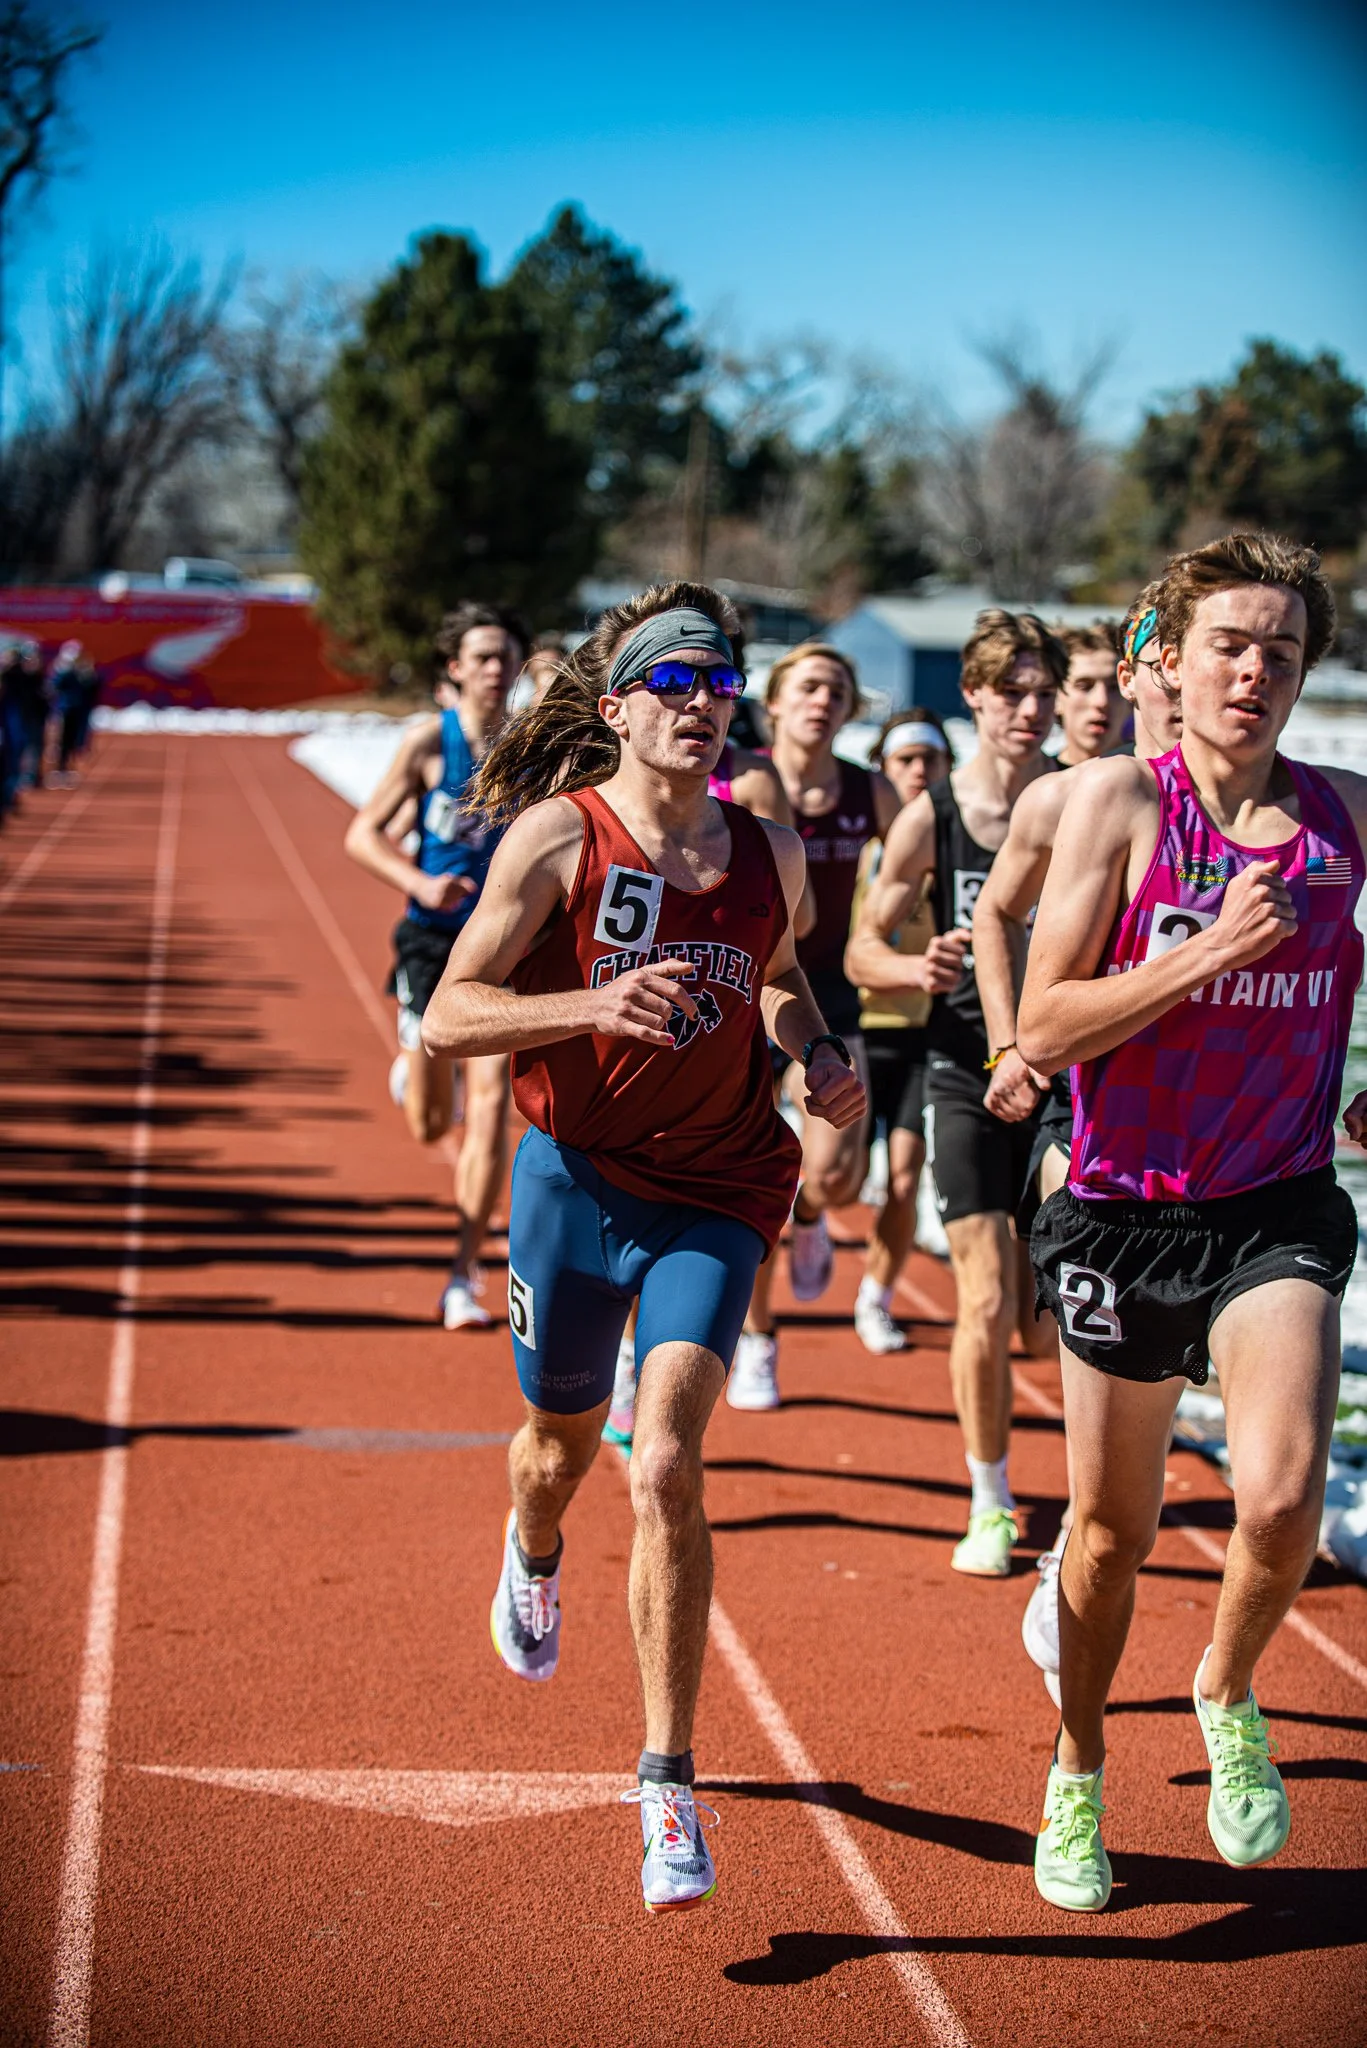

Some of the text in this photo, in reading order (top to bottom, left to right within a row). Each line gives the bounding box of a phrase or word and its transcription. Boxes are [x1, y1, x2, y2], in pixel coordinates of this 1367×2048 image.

[604, 872, 652, 943] 5
[590, 941, 757, 1004] CHATFIEL
[1308, 966, 1337, 1007] VI
[509, 1271, 527, 1337] 5
[1066, 1271, 1111, 1336] 2
